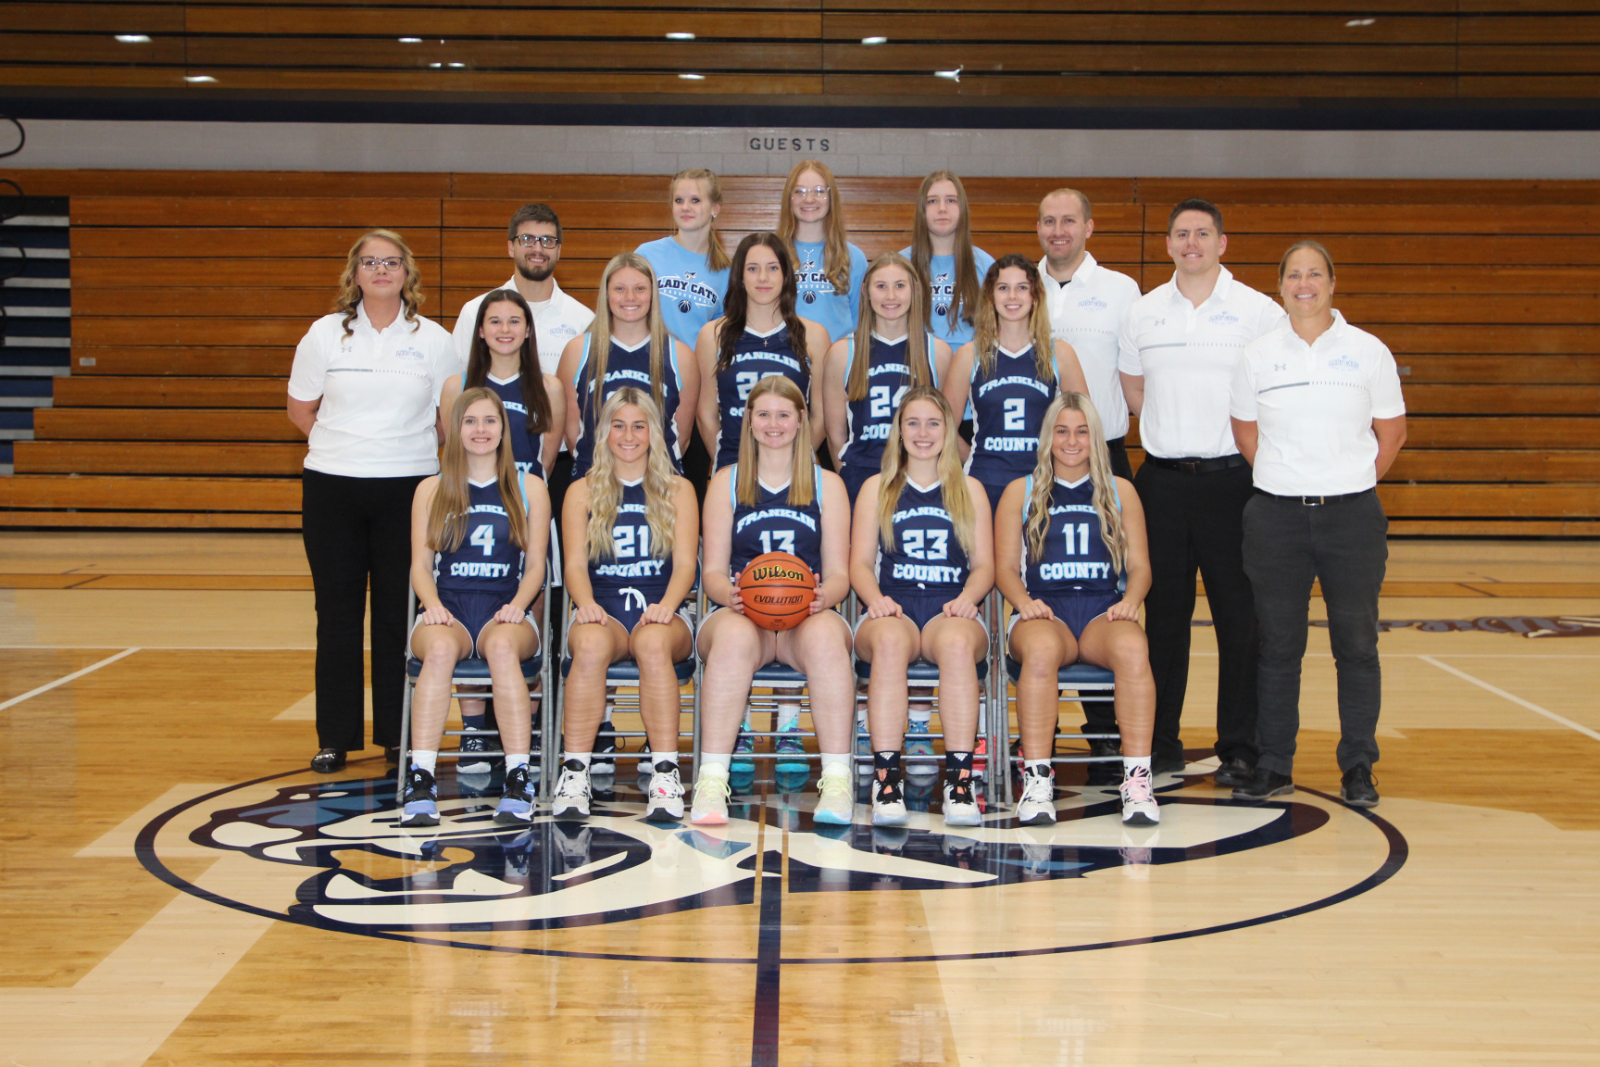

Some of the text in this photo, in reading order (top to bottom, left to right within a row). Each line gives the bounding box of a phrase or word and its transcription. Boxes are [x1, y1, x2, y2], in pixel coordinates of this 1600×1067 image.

[750, 138, 830, 151] GUESTS
[658, 279, 718, 304] LADY CATS
[731, 351, 801, 373] RANKLIN
[736, 372, 784, 400] 2
[979, 375, 1049, 398] FRANKLIN
[1003, 398, 1026, 431] 2
[860, 423, 893, 440] COU
[736, 508, 817, 534] FRANKLIN
[470, 525, 496, 556] 4
[612, 525, 650, 558] 21
[758, 529, 796, 556] 13
[902, 528, 949, 560] 23
[1061, 522, 1090, 556] 11
[450, 562, 511, 578] COUNTY
[753, 565, 805, 582] Wilson
[892, 563, 962, 583] COUNTY
[1040, 561, 1111, 580] COUNTY
[754, 595, 804, 605] EVOLUTION
